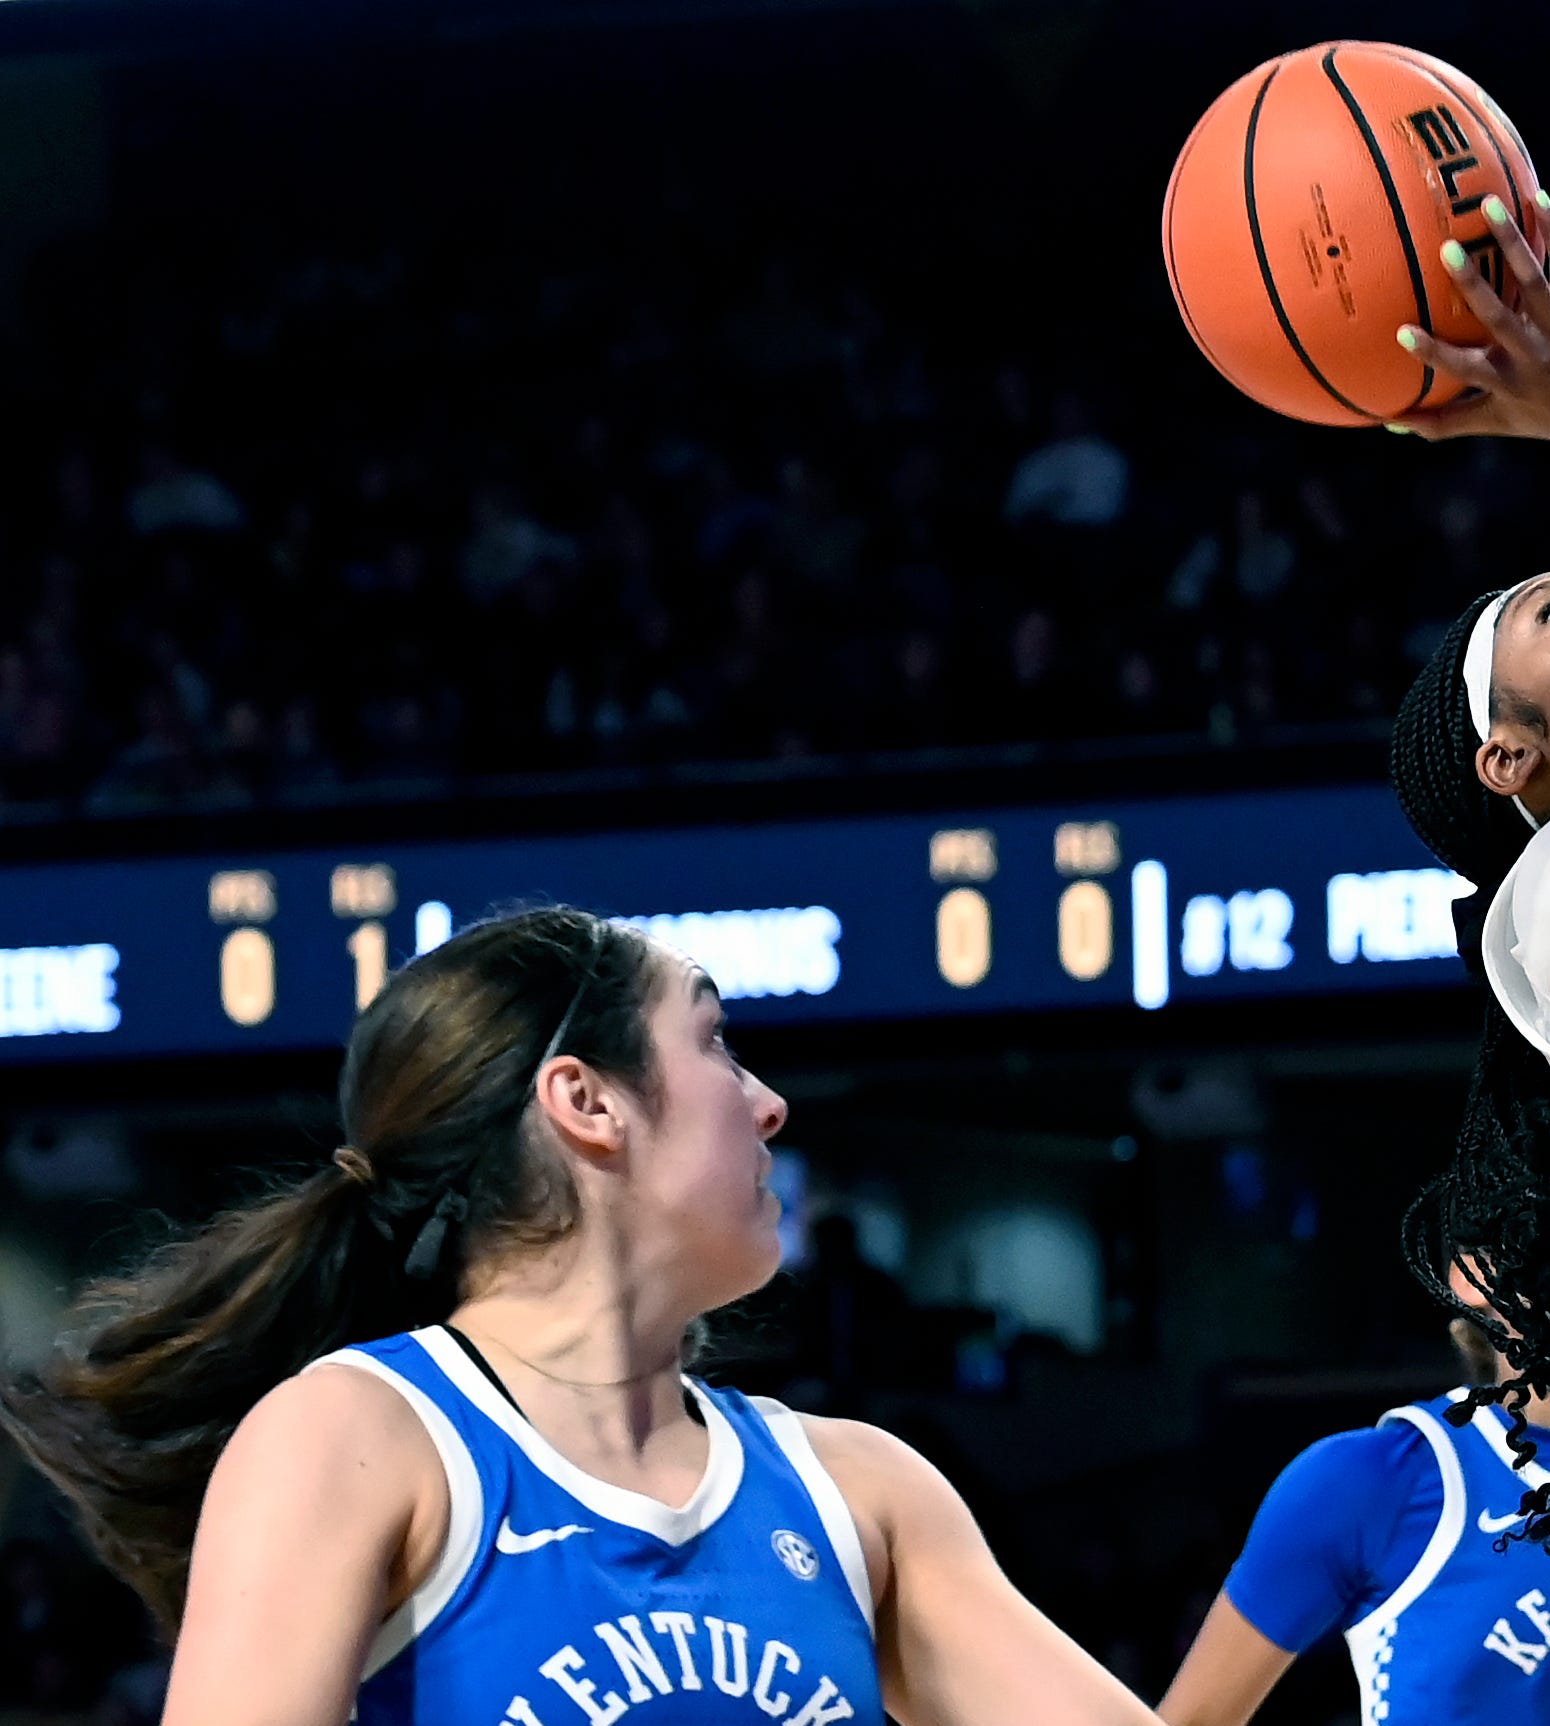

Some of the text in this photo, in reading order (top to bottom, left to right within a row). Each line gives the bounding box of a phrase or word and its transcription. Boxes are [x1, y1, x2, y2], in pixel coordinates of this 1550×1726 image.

[1408, 104, 1504, 300] ELI
[220, 926, 276, 1026] 0
[347, 920, 388, 1015] 1
[936, 887, 992, 990] 0
[1058, 880, 1113, 982] 0
